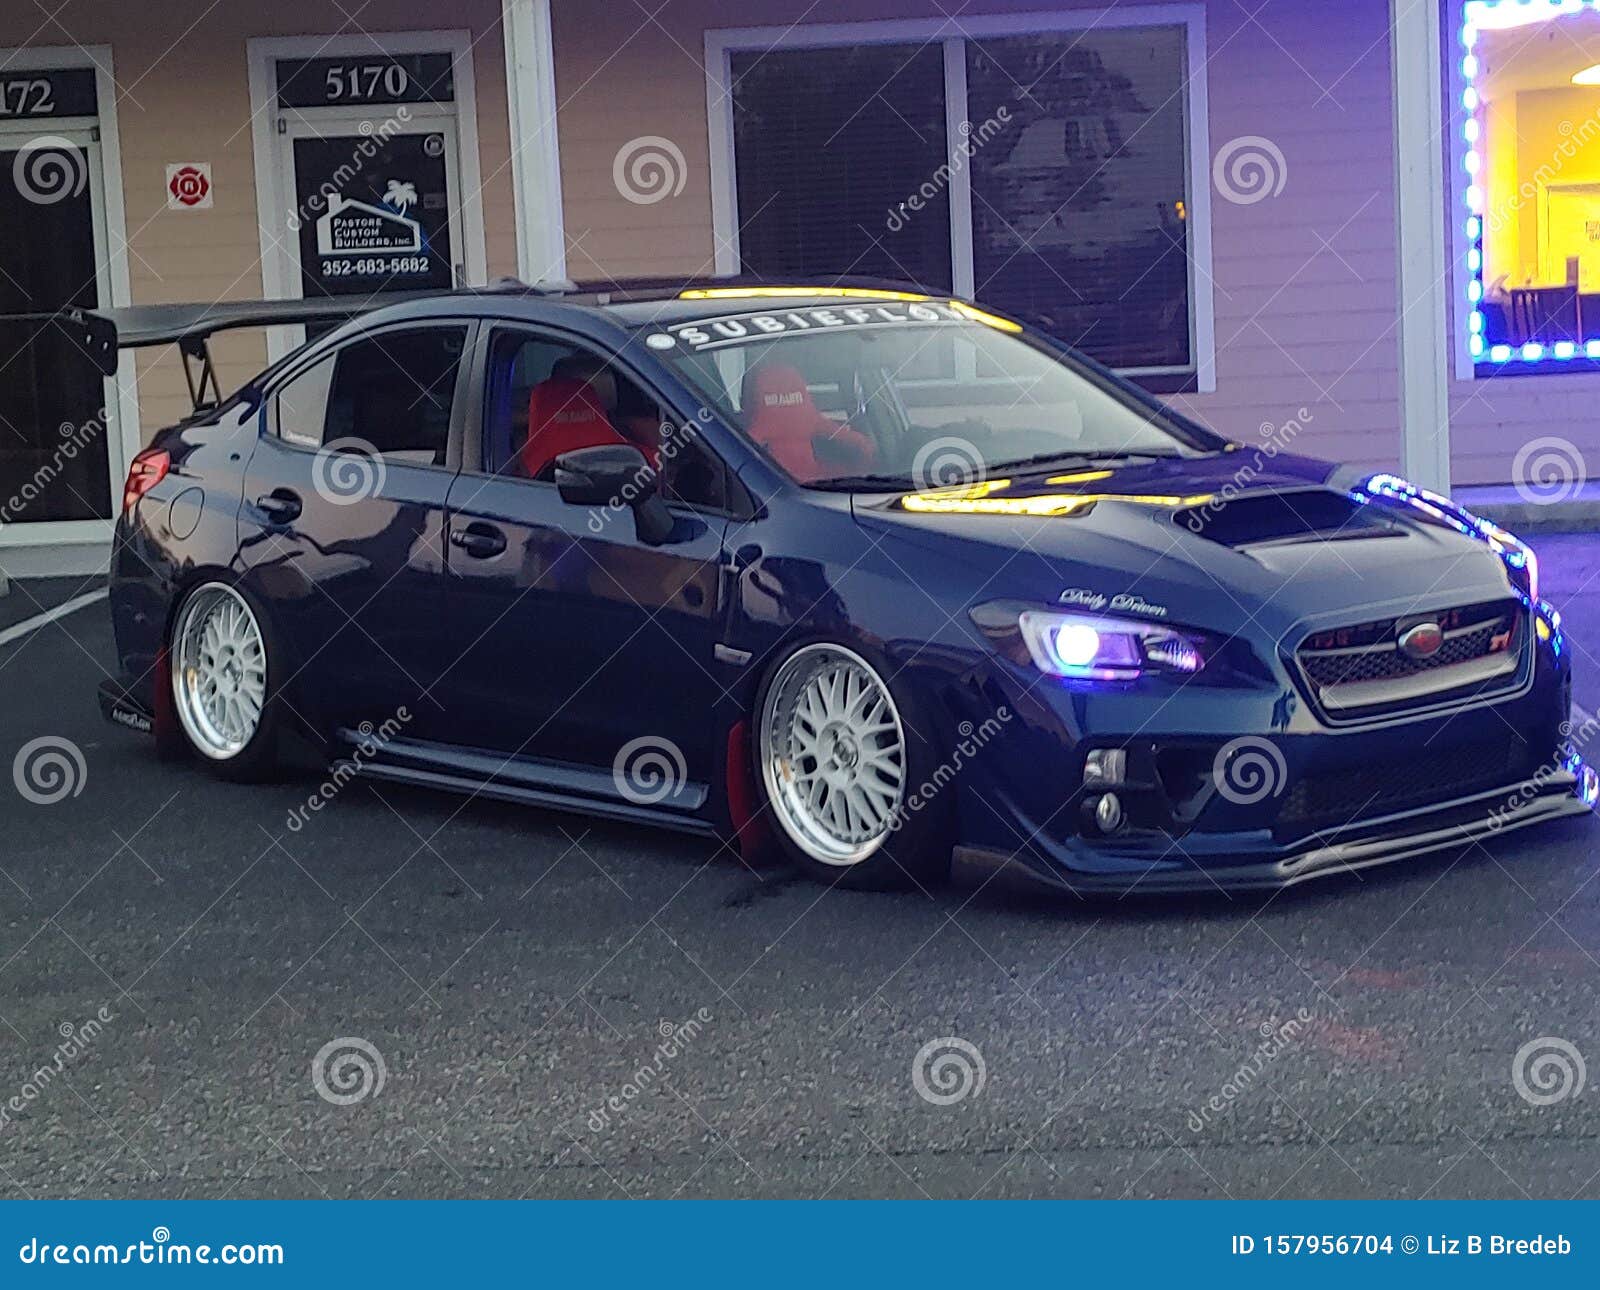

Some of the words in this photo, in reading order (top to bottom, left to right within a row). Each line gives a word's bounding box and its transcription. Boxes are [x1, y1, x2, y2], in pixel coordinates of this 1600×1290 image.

[326, 64, 408, 99] 5170
[333, 218, 382, 228] PASTORE
[334, 228, 379, 237] CUSTOM
